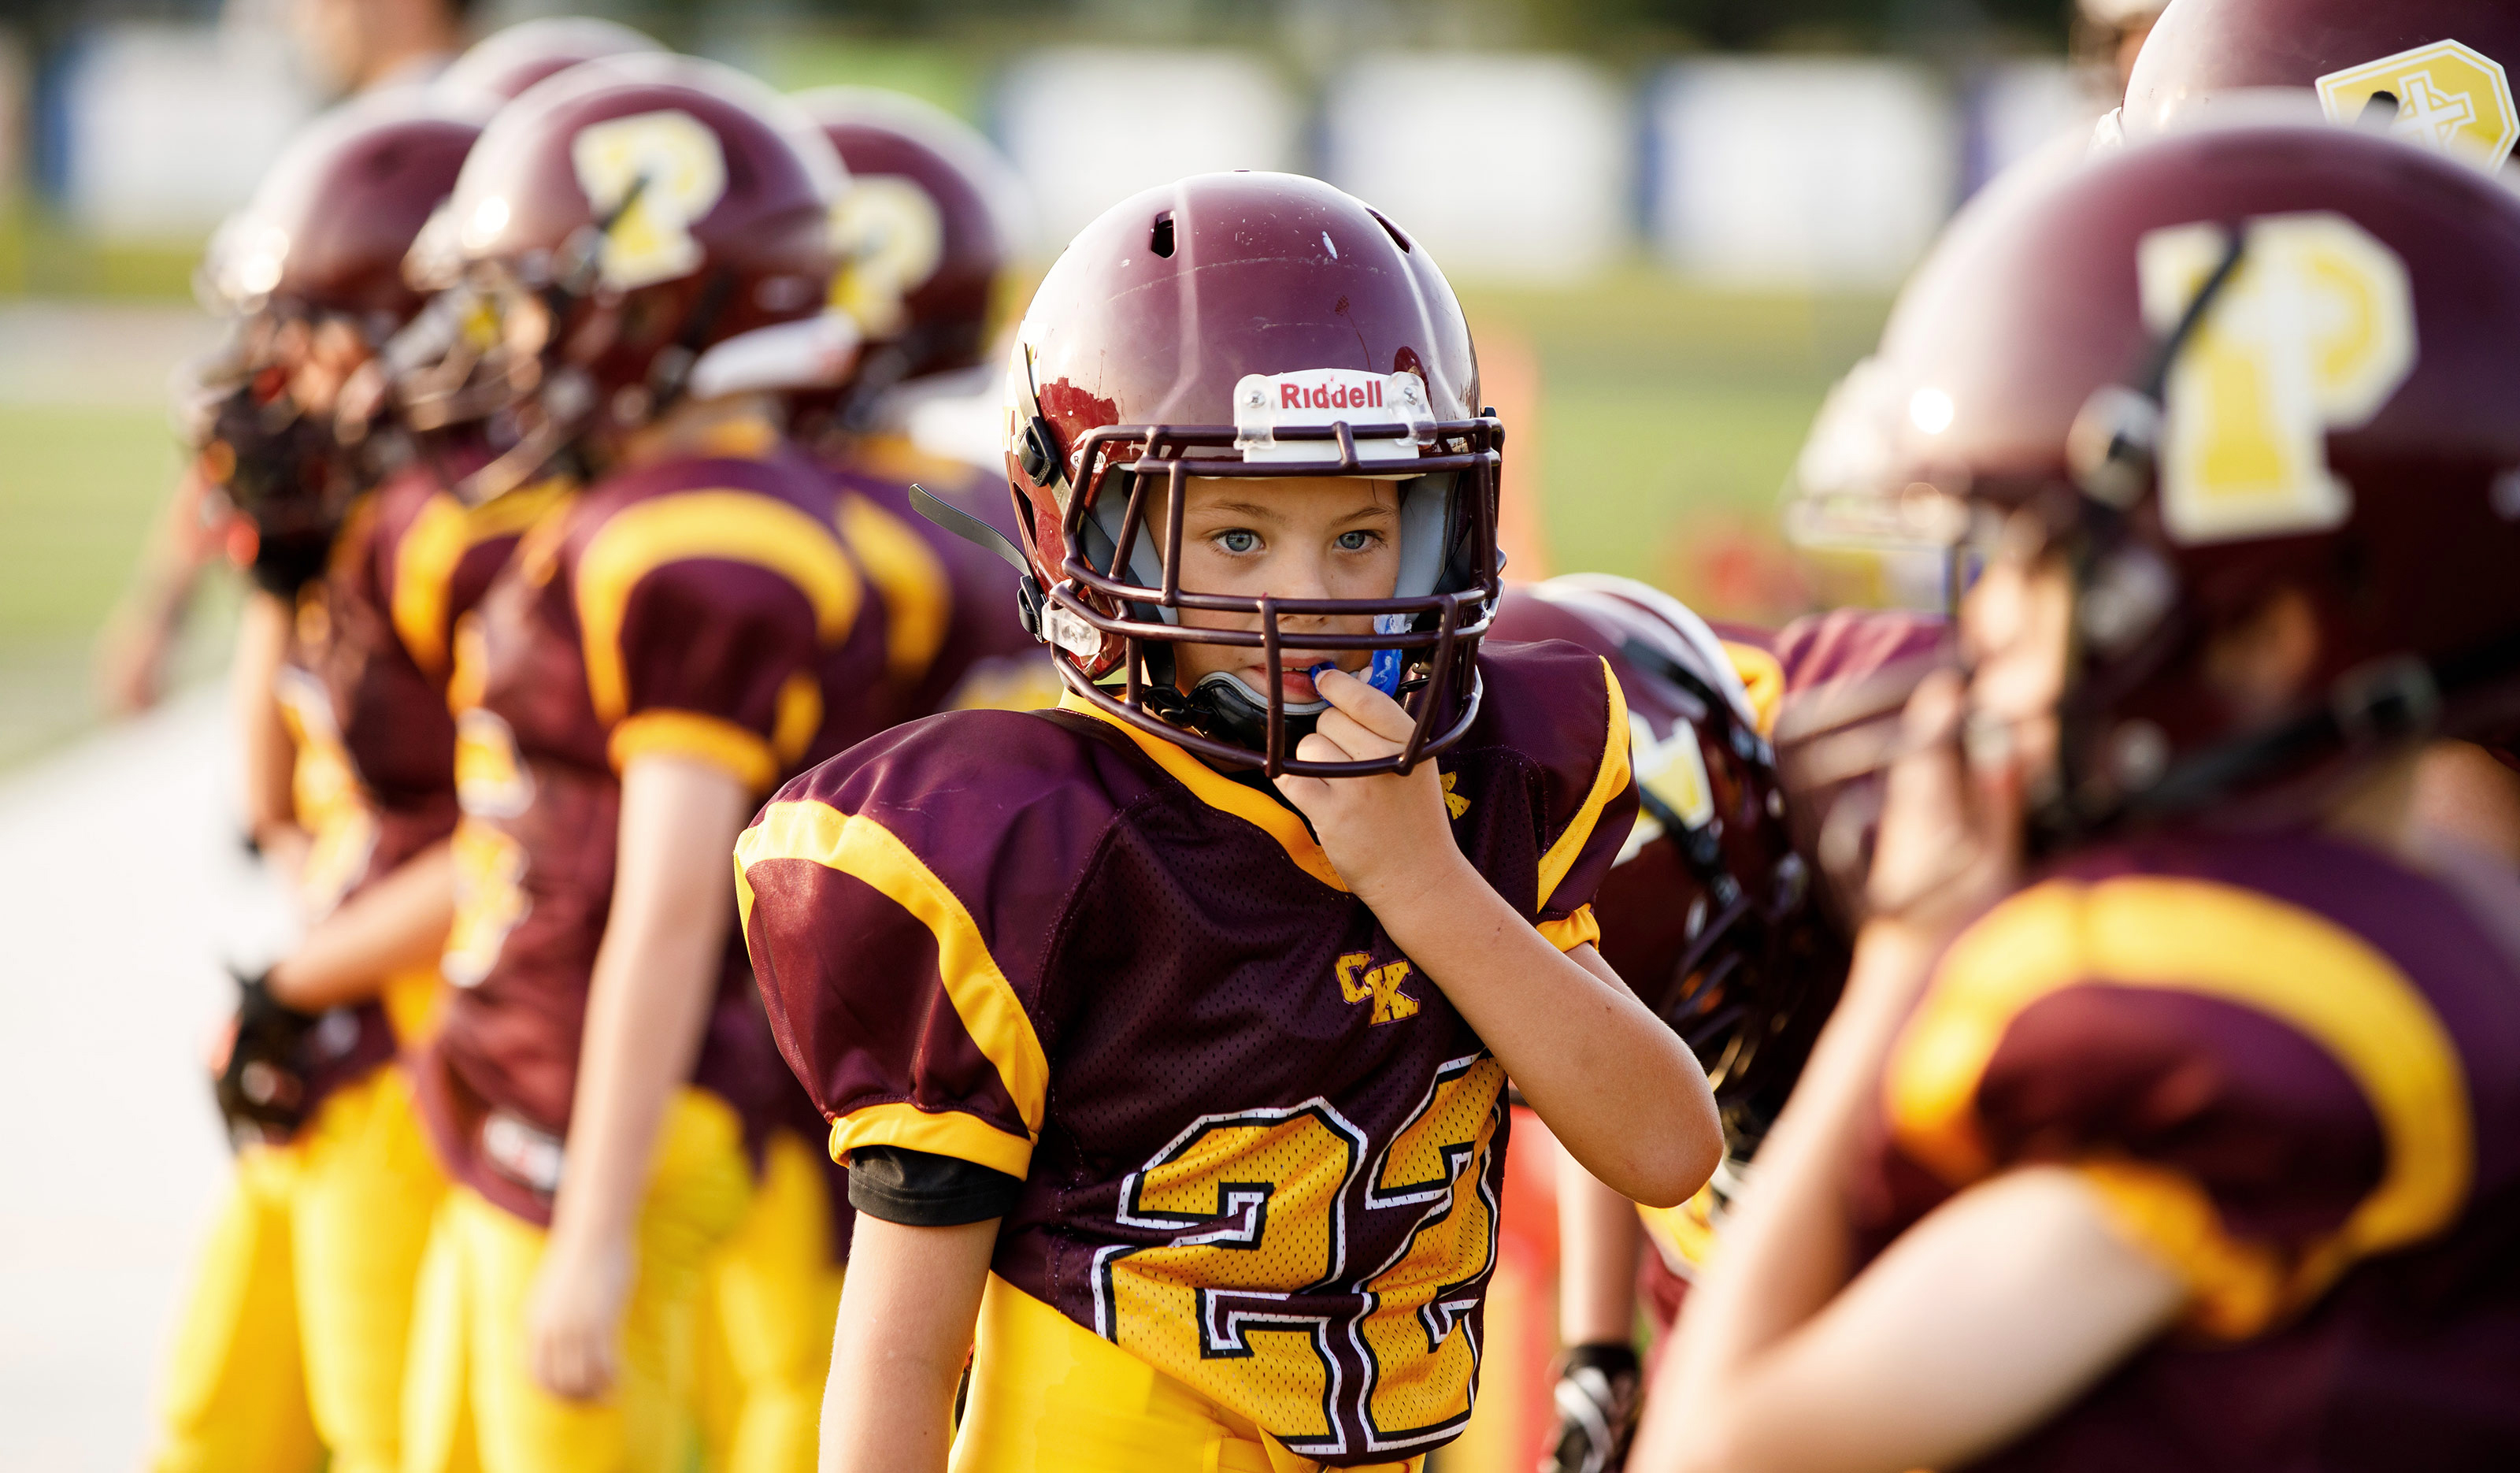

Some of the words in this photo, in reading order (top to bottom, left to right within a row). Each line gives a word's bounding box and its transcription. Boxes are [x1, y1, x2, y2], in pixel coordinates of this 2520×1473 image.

[1280, 380, 1384, 410] Riddell
[2135, 210, 2421, 547] P
[1335, 951, 1421, 1028] CK
[1091, 1048, 1504, 1455] 22
